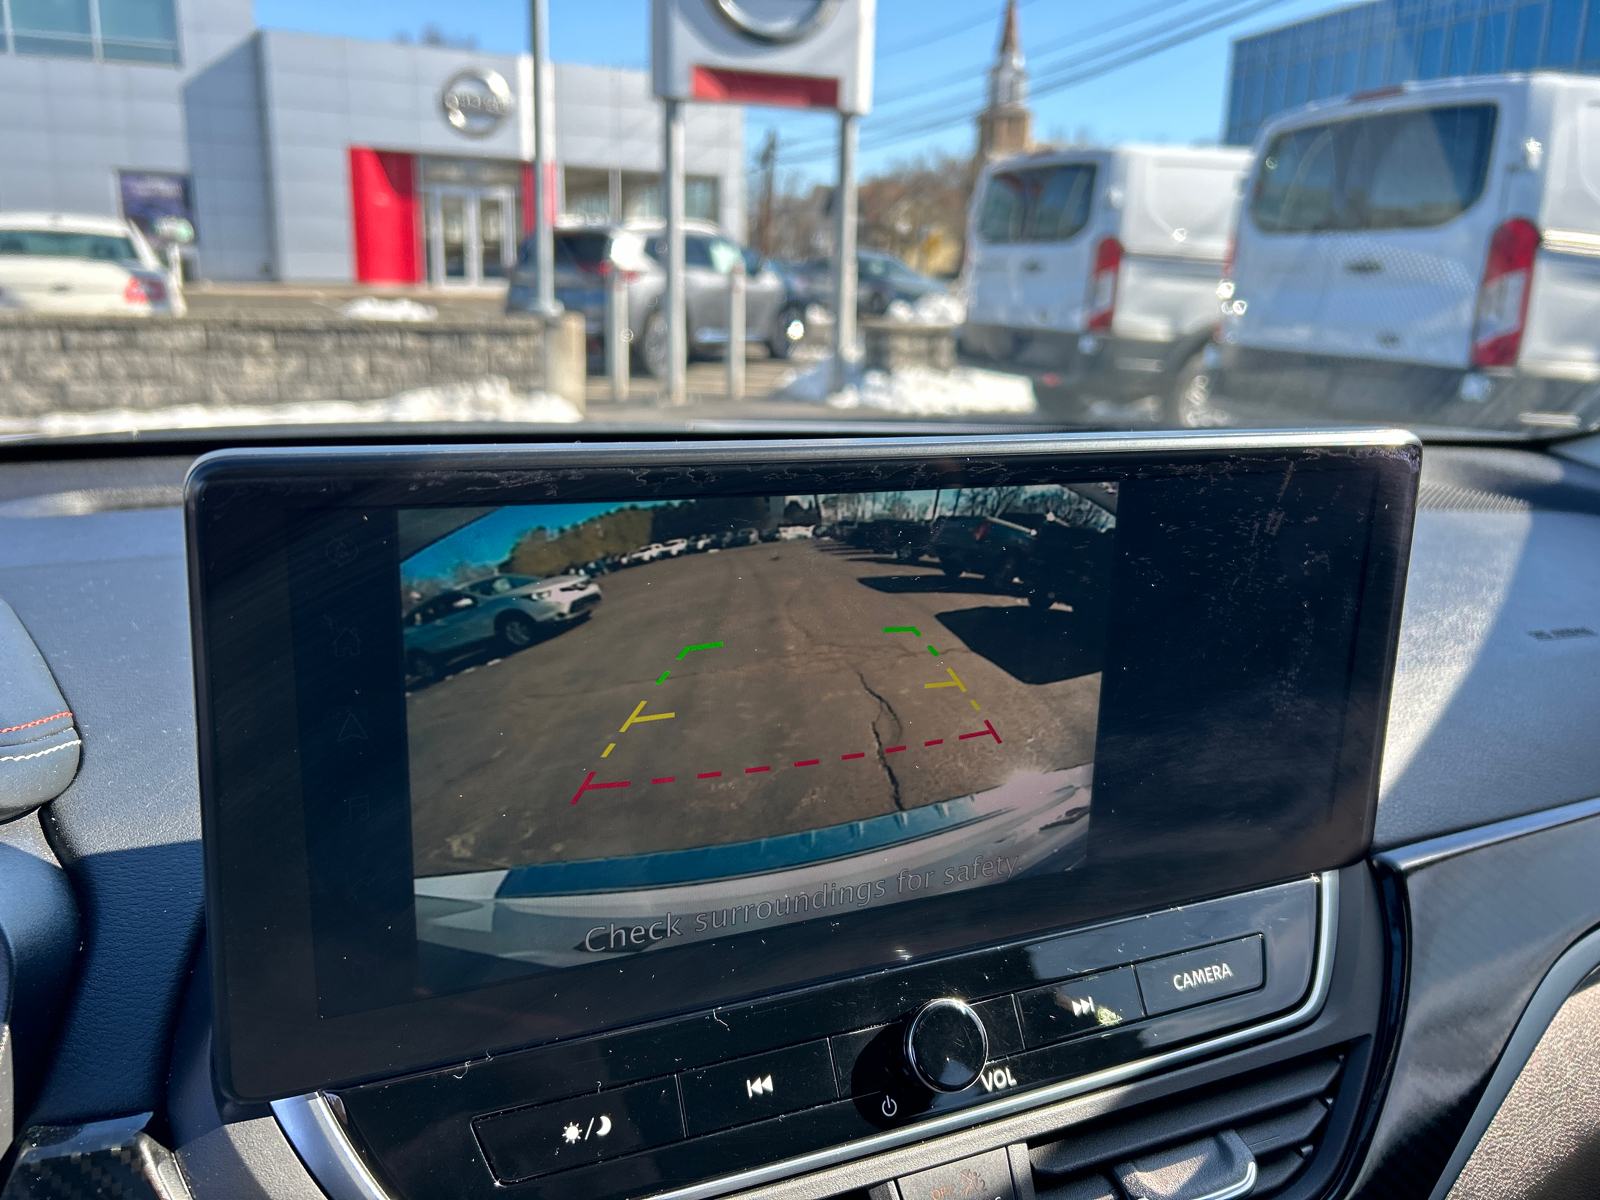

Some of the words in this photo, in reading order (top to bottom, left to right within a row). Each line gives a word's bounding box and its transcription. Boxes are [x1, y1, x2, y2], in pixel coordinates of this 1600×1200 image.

[585, 912, 683, 952] Check
[694, 878, 886, 933] surroundings
[897, 868, 935, 893] for
[943, 855, 1023, 885] safety.
[1173, 963, 1233, 991] CAMERA
[980, 1066, 1018, 1091] VOL
